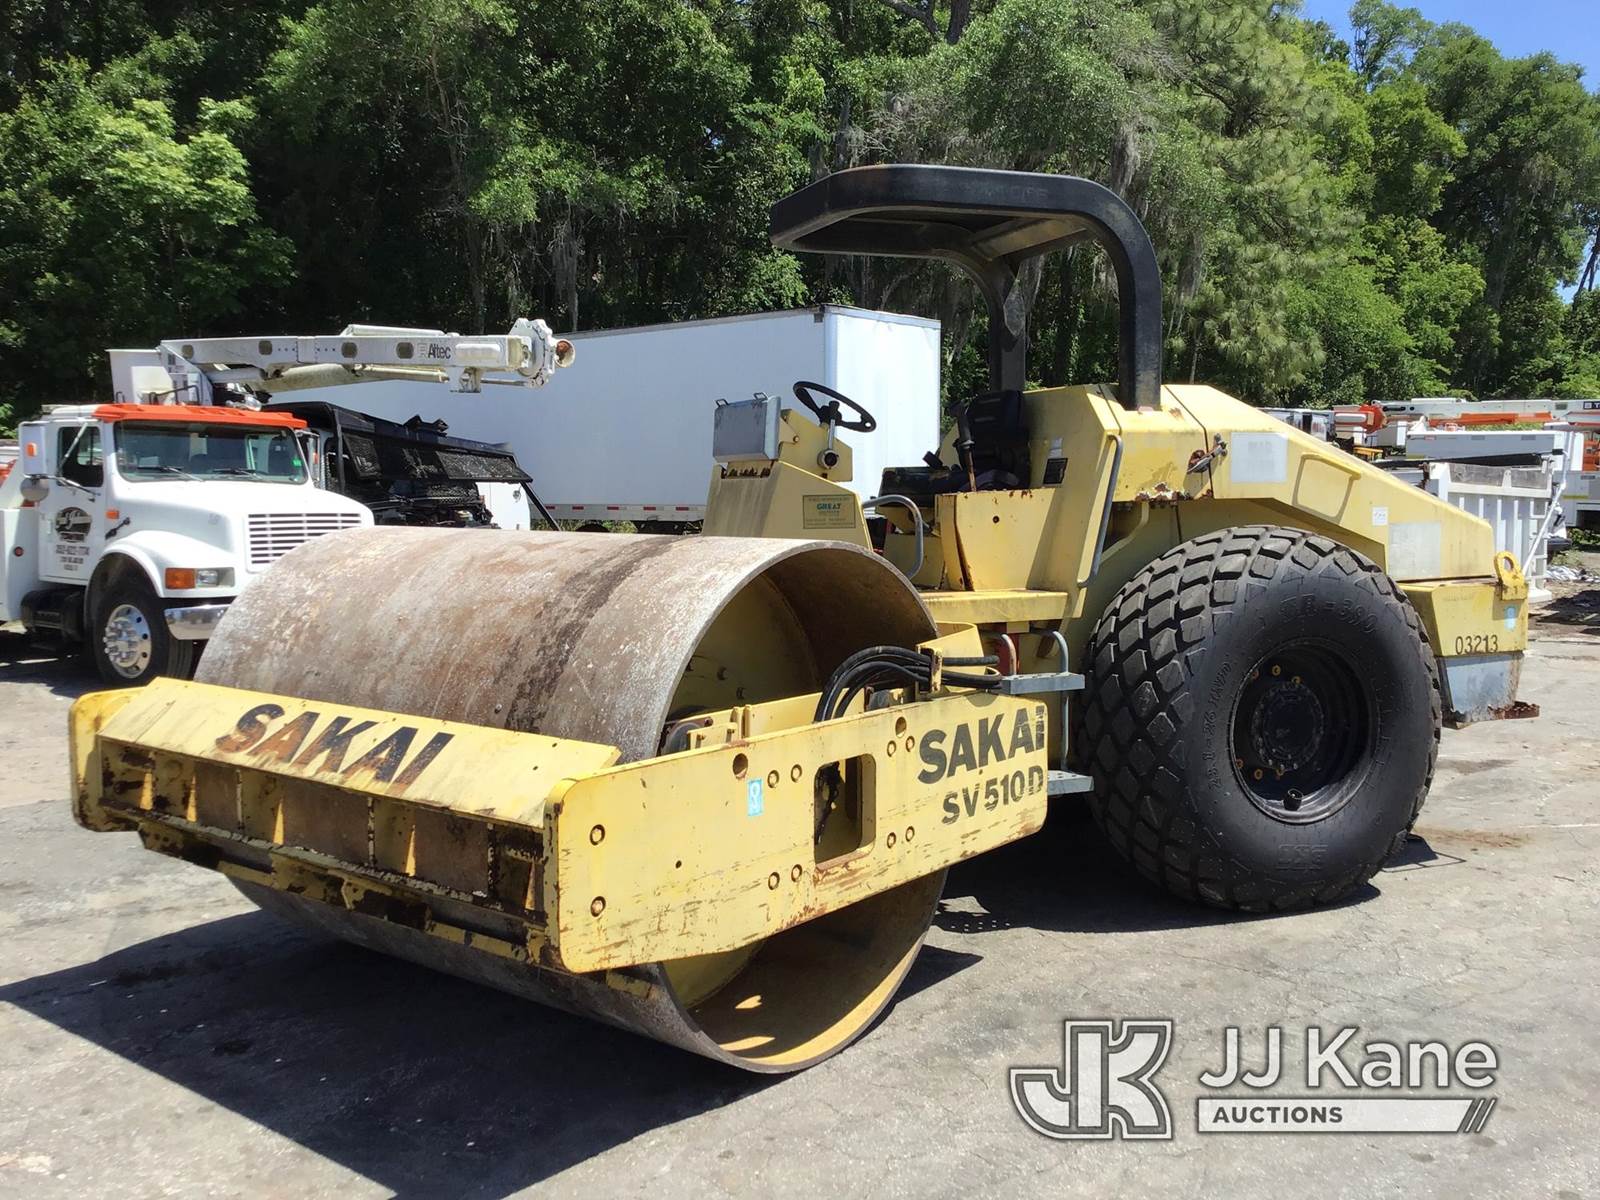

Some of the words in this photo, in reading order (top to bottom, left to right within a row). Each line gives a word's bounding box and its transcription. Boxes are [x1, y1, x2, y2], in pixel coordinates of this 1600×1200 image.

[428, 343, 452, 360] Altec
[1455, 634, 1499, 655] 03213
[215, 703, 456, 796] SAKAI
[917, 705, 1046, 785] SAKAI
